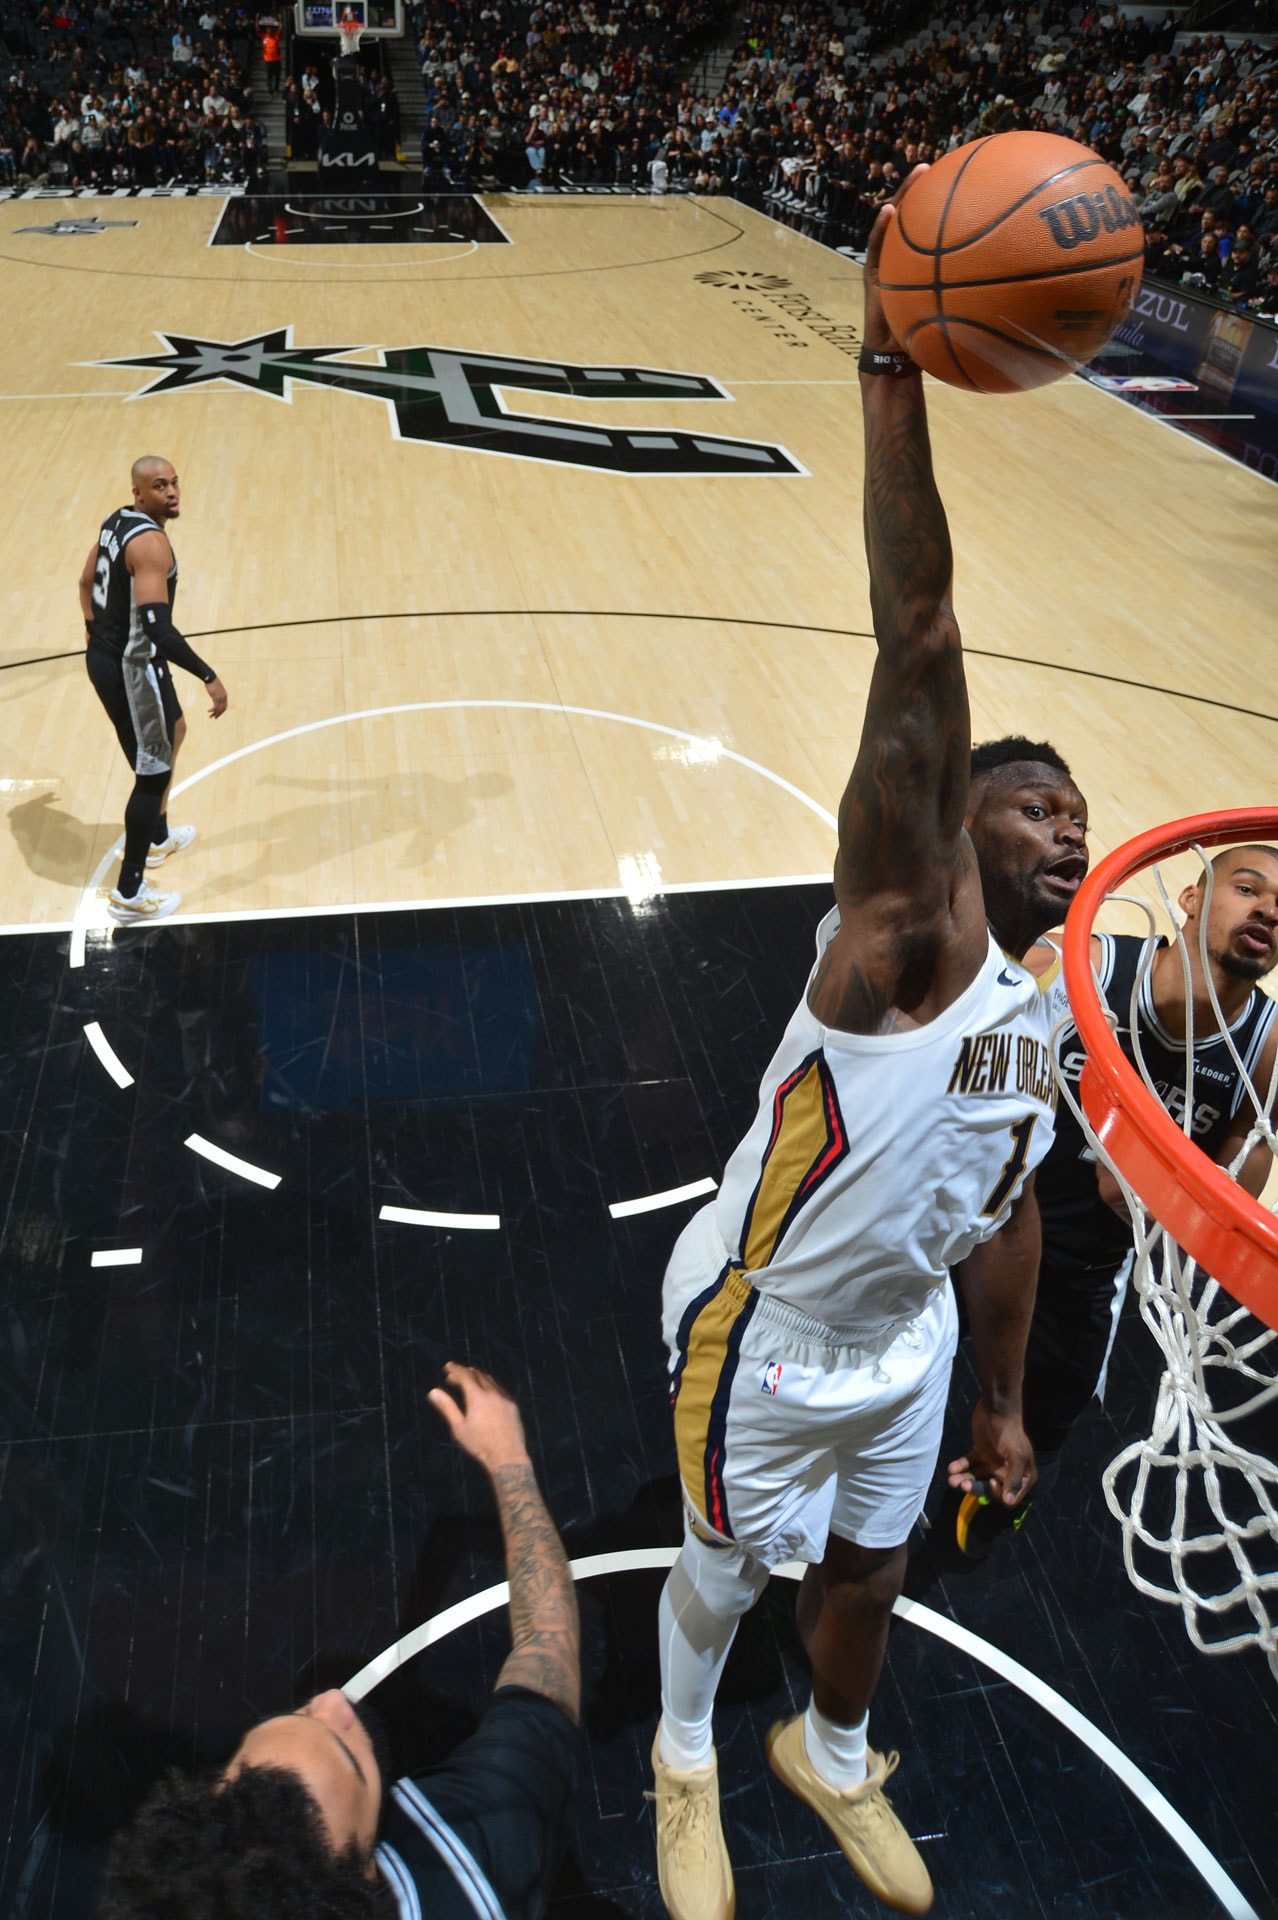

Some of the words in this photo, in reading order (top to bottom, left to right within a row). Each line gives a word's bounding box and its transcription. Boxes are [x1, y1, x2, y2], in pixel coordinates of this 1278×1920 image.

[731, 300, 809, 348] CENTER
[945, 1033, 1013, 1095] NEW
[1194, 1064, 1231, 1083] LEDGER
[979, 1112, 1040, 1218] 1
